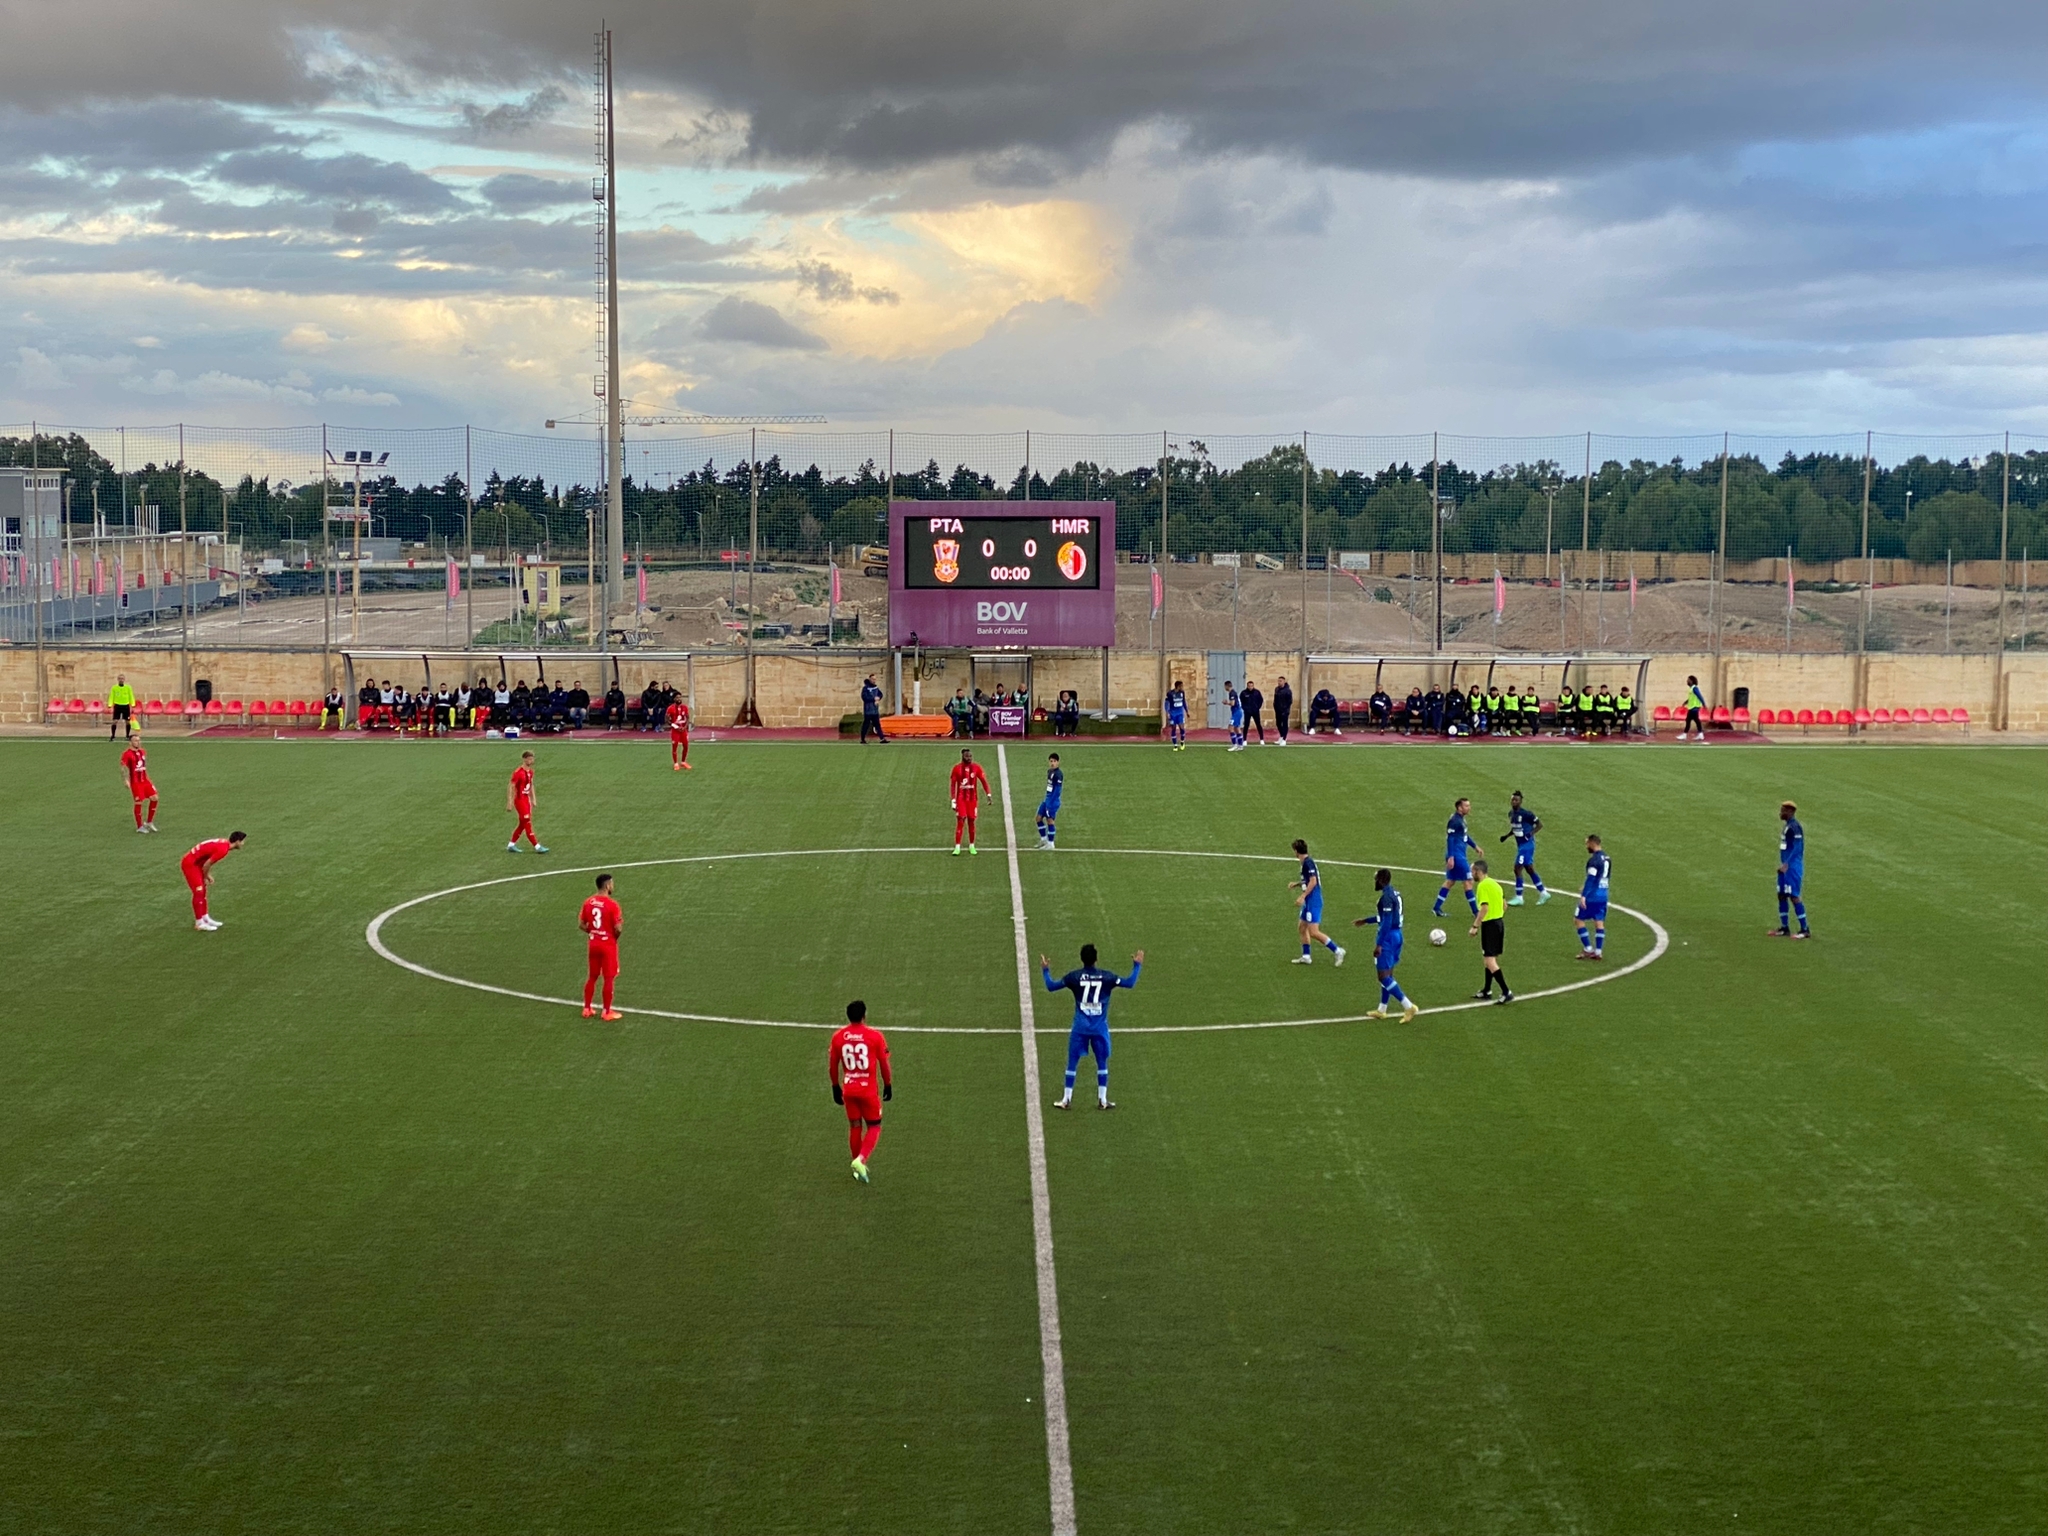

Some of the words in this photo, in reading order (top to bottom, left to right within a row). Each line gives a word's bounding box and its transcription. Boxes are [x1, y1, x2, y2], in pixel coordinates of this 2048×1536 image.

[930, 518, 964, 533] PTA
[1052, 518, 1090, 534] HMR
[982, 539, 995, 557] 0
[1024, 539, 1037, 557] 0
[990, 566, 1031, 580] 00:00
[977, 601, 1028, 621] BOV
[977, 627, 993, 635] Bank
[994, 627, 1002, 635] of
[1002, 627, 1028, 635] Valletta
[591, 907, 602, 930] 3
[1080, 981, 1102, 1004] 77
[842, 1043, 869, 1070] 63
